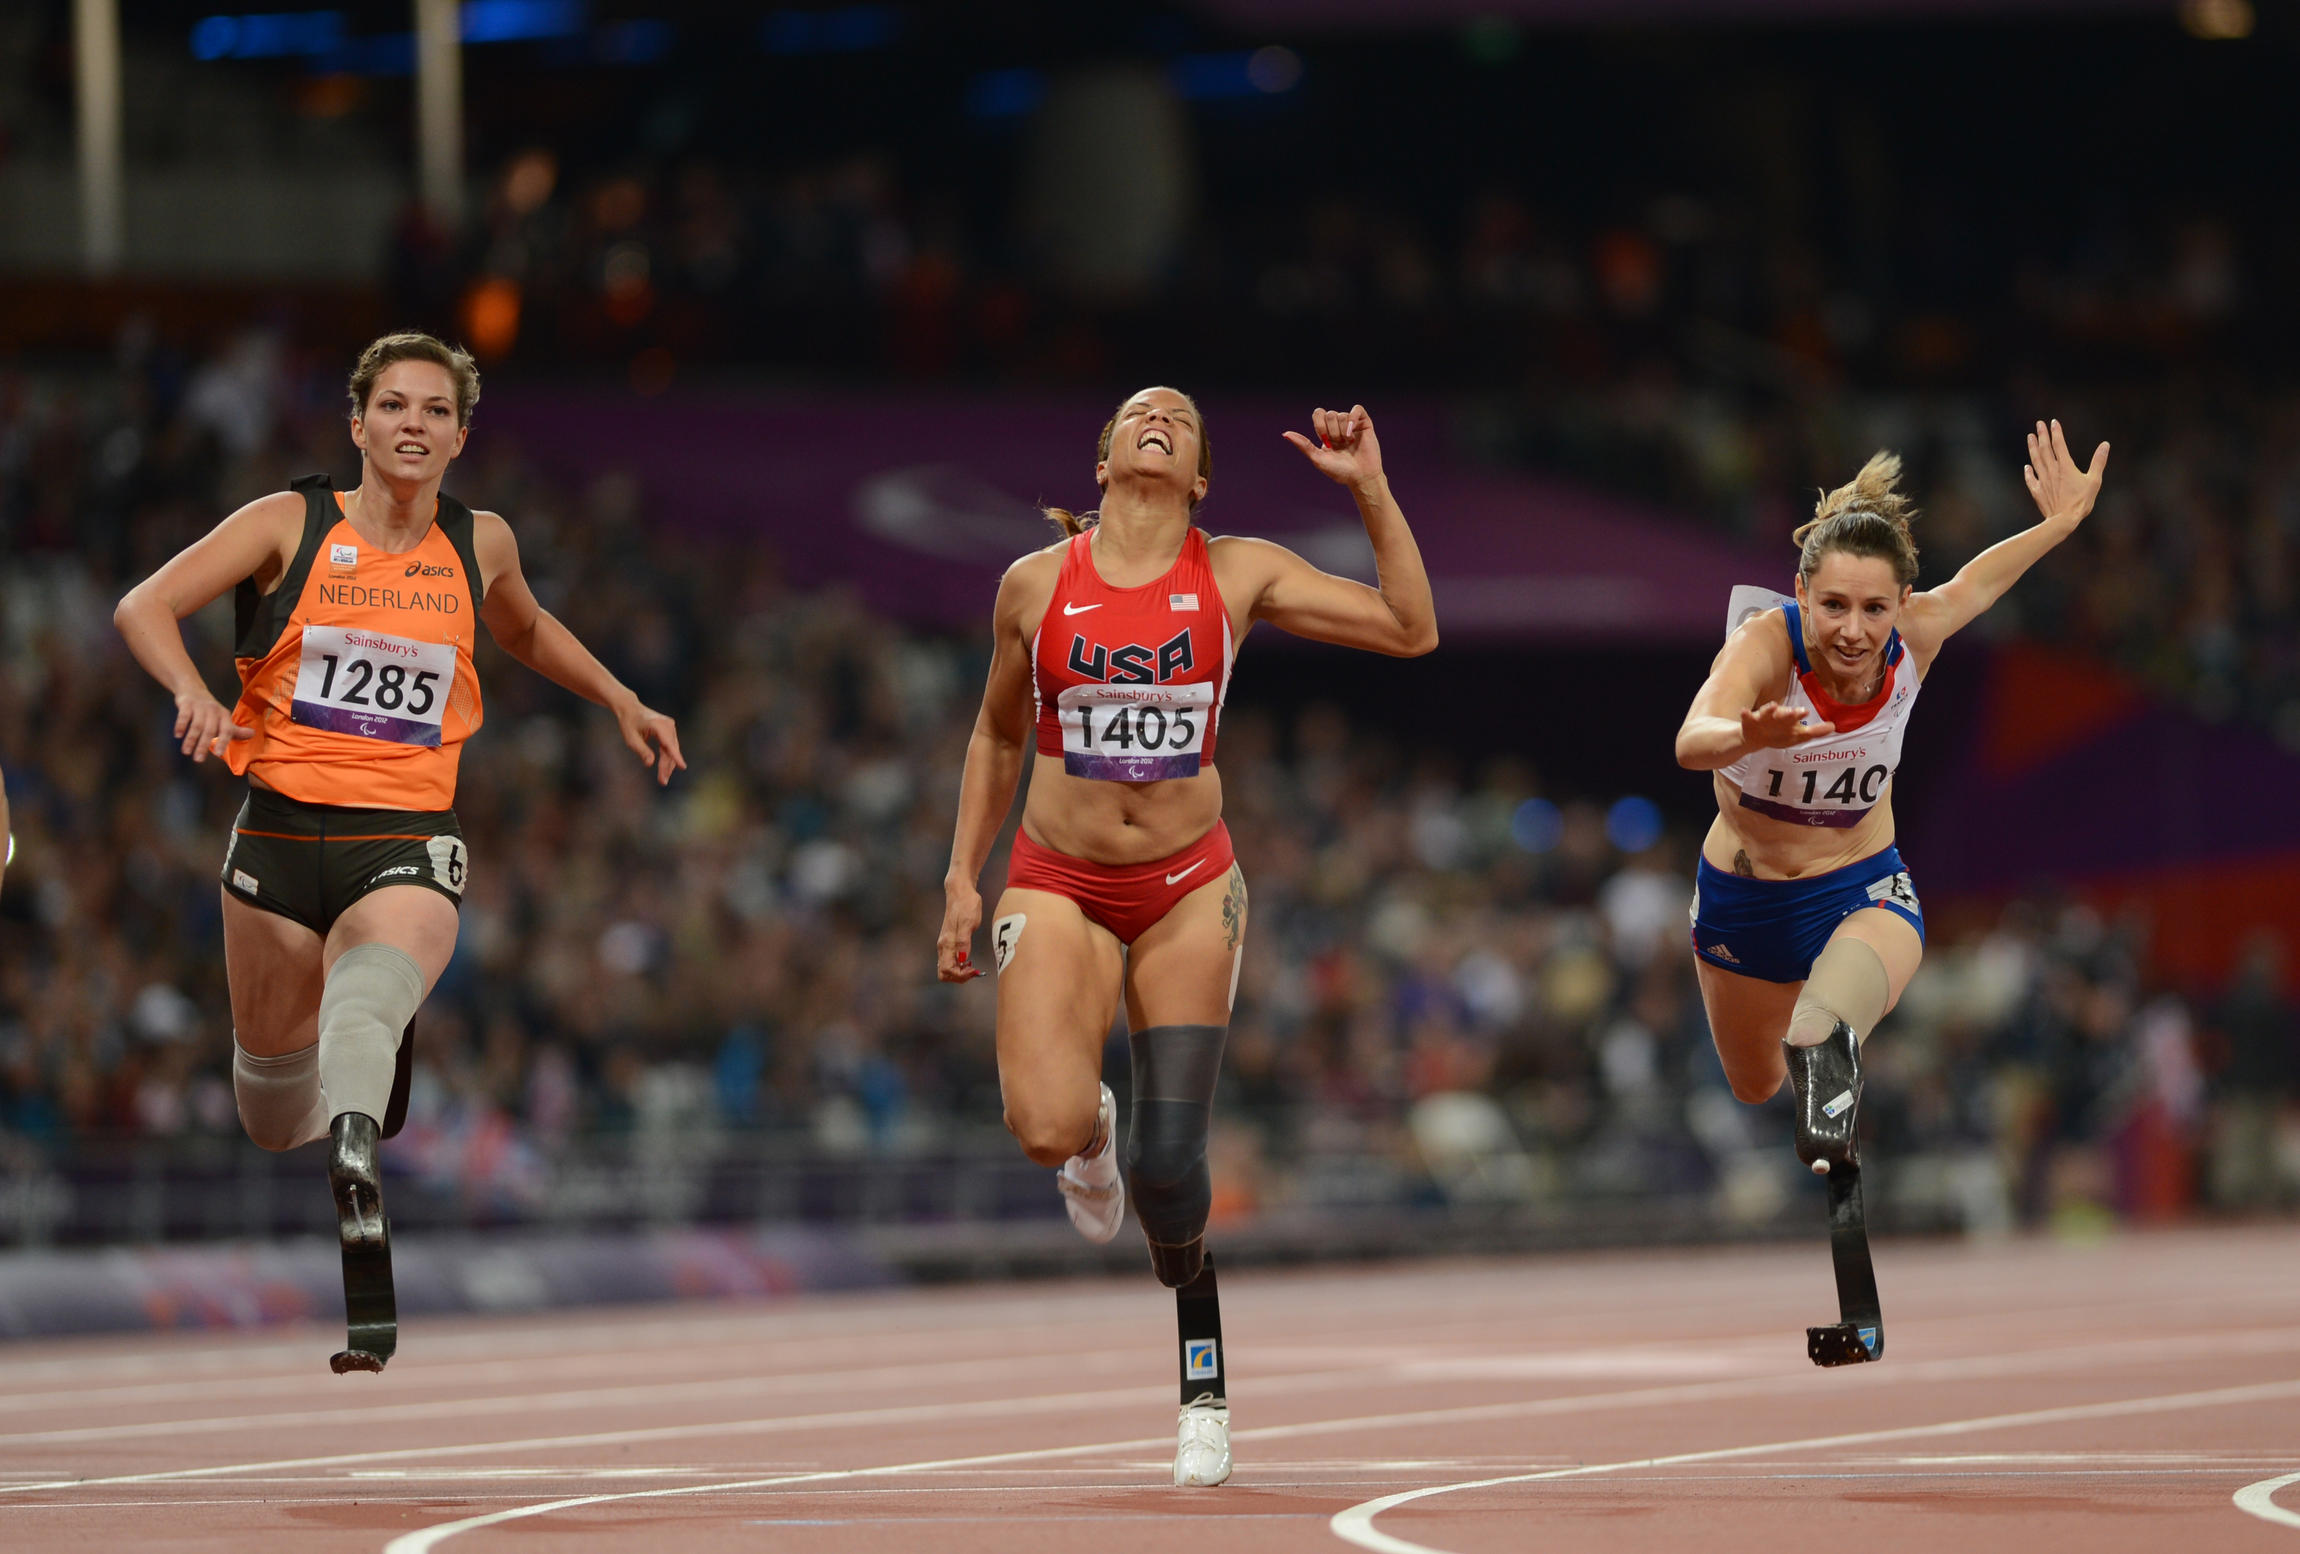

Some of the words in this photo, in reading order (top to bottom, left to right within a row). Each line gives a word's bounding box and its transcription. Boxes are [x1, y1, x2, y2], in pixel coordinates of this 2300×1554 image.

[319, 583, 459, 614] NEDERLAND
[344, 632, 419, 658] Sainsbury's
[1067, 627, 1195, 685] USA
[319, 654, 440, 715] 1285
[1096, 688, 1173, 703] Sainsbury's
[352, 712, 373, 721] London
[374, 716, 388, 724] 2012
[1077, 705, 1196, 751] 1405
[1119, 757, 1139, 765] London
[1140, 757, 1154, 765] 2012
[1792, 746, 1867, 764] Sainsbury's
[1767, 764, 1888, 804] 1140
[448, 844, 463, 887] 6
[998, 921, 1011, 970] 5
